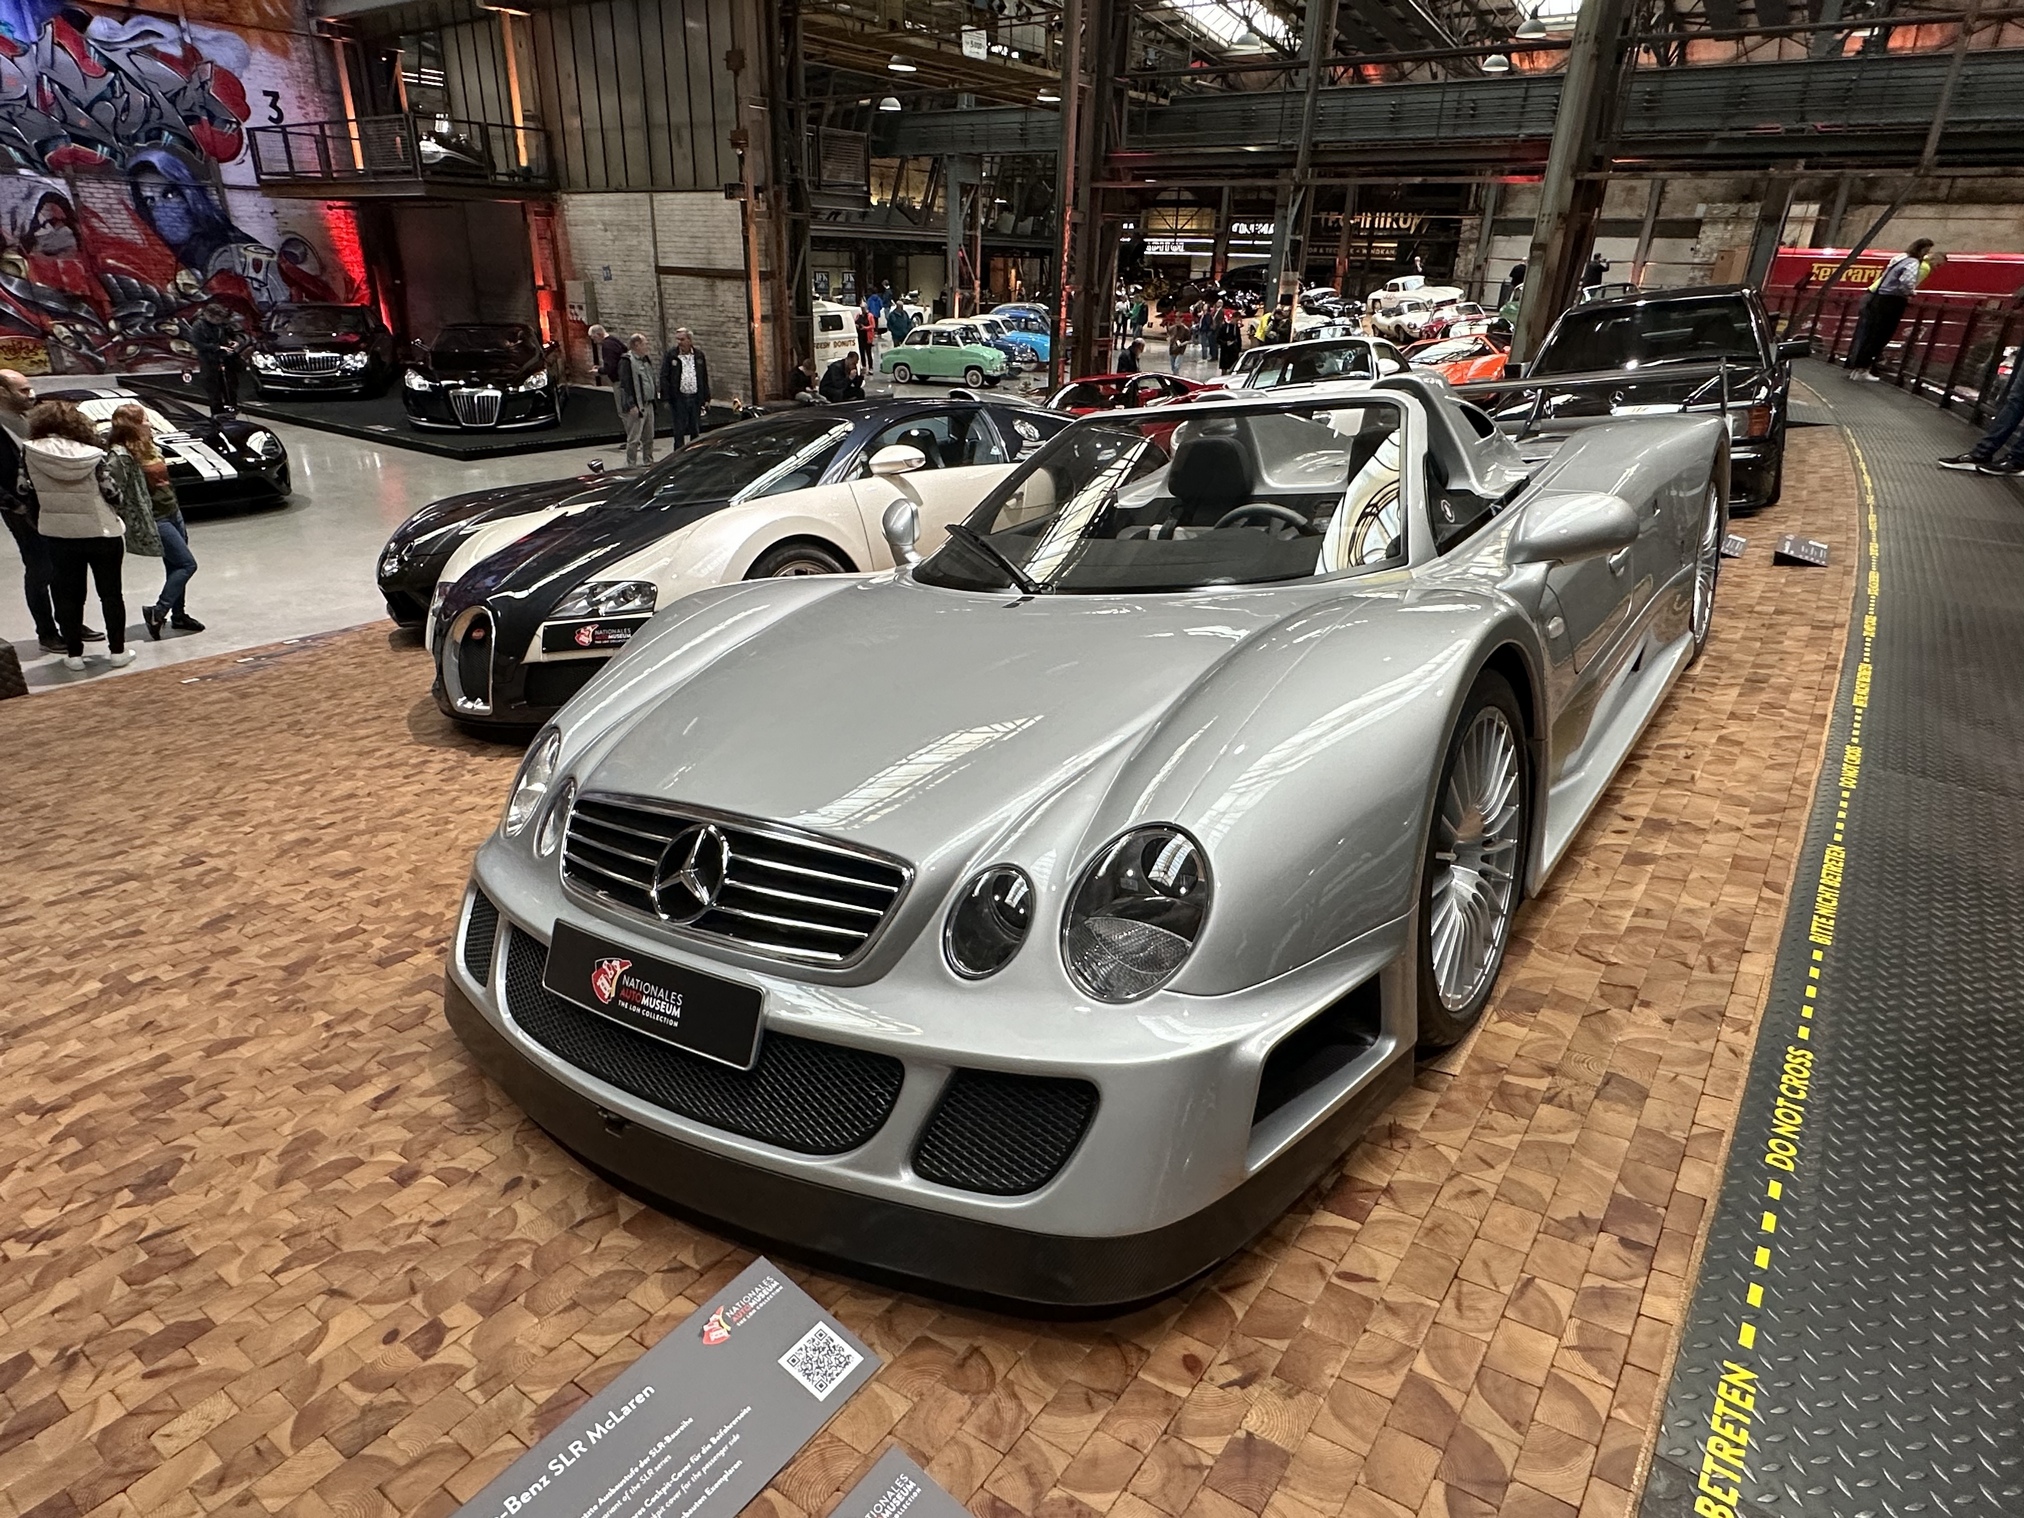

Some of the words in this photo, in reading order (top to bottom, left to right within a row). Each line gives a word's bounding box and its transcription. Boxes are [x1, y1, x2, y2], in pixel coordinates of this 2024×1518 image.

[262, 90, 284, 124] 3
[1809, 263, 1884, 283] Ferari
[834, 339, 856, 348] DONUTS
[1819, 843, 1846, 888] BETRETEN
[1814, 884, 1840, 918] NICHT
[1808, 914, 1835, 946] BITTE
[622, 974, 683, 1006] NATIONALES
[618, 999, 629, 1009] THE
[642, 1008, 679, 1028] COLLECTION
[1779, 1045, 1814, 1100] CROSS
[1770, 1096, 1805, 1140] NOT
[1764, 1138, 1798, 1172] DO
[725, 1275, 774, 1318] NATIONALES
[756, 1285, 784, 1310] COLLECTION
[494, 1475, 551, 1518] -Benz
[548, 1440, 588, 1476] SLR
[586, 1385, 655, 1444] McLaren
[644, 1463, 692, 1507] Cockpit-Cover
[690, 1453, 701, 1464] für
[701, 1443, 712, 1454] die
[710, 1406, 752, 1445] Beifahrerseite
[1694, 1359, 1759, 1518] BETRETEN
[581, 1504, 599, 1518] tzte
[598, 1467, 639, 1506] Ausbaustufe
[639, 1456, 650, 1468] der
[649, 1417, 693, 1458] SLR-Baureihe
[622, 1490, 631, 1501] of
[629, 1482, 641, 1495] the
[639, 1468, 655, 1484] SLR
[654, 1455, 671, 1471] series
[665, 1490, 681, 1507] cover
[681, 1481, 691, 1494] for
[690, 1471, 702, 1482] the
[701, 1444, 728, 1475] passenger
[728, 1433, 740, 1446] side
[704, 1460, 743, 1496] Exemplaren
